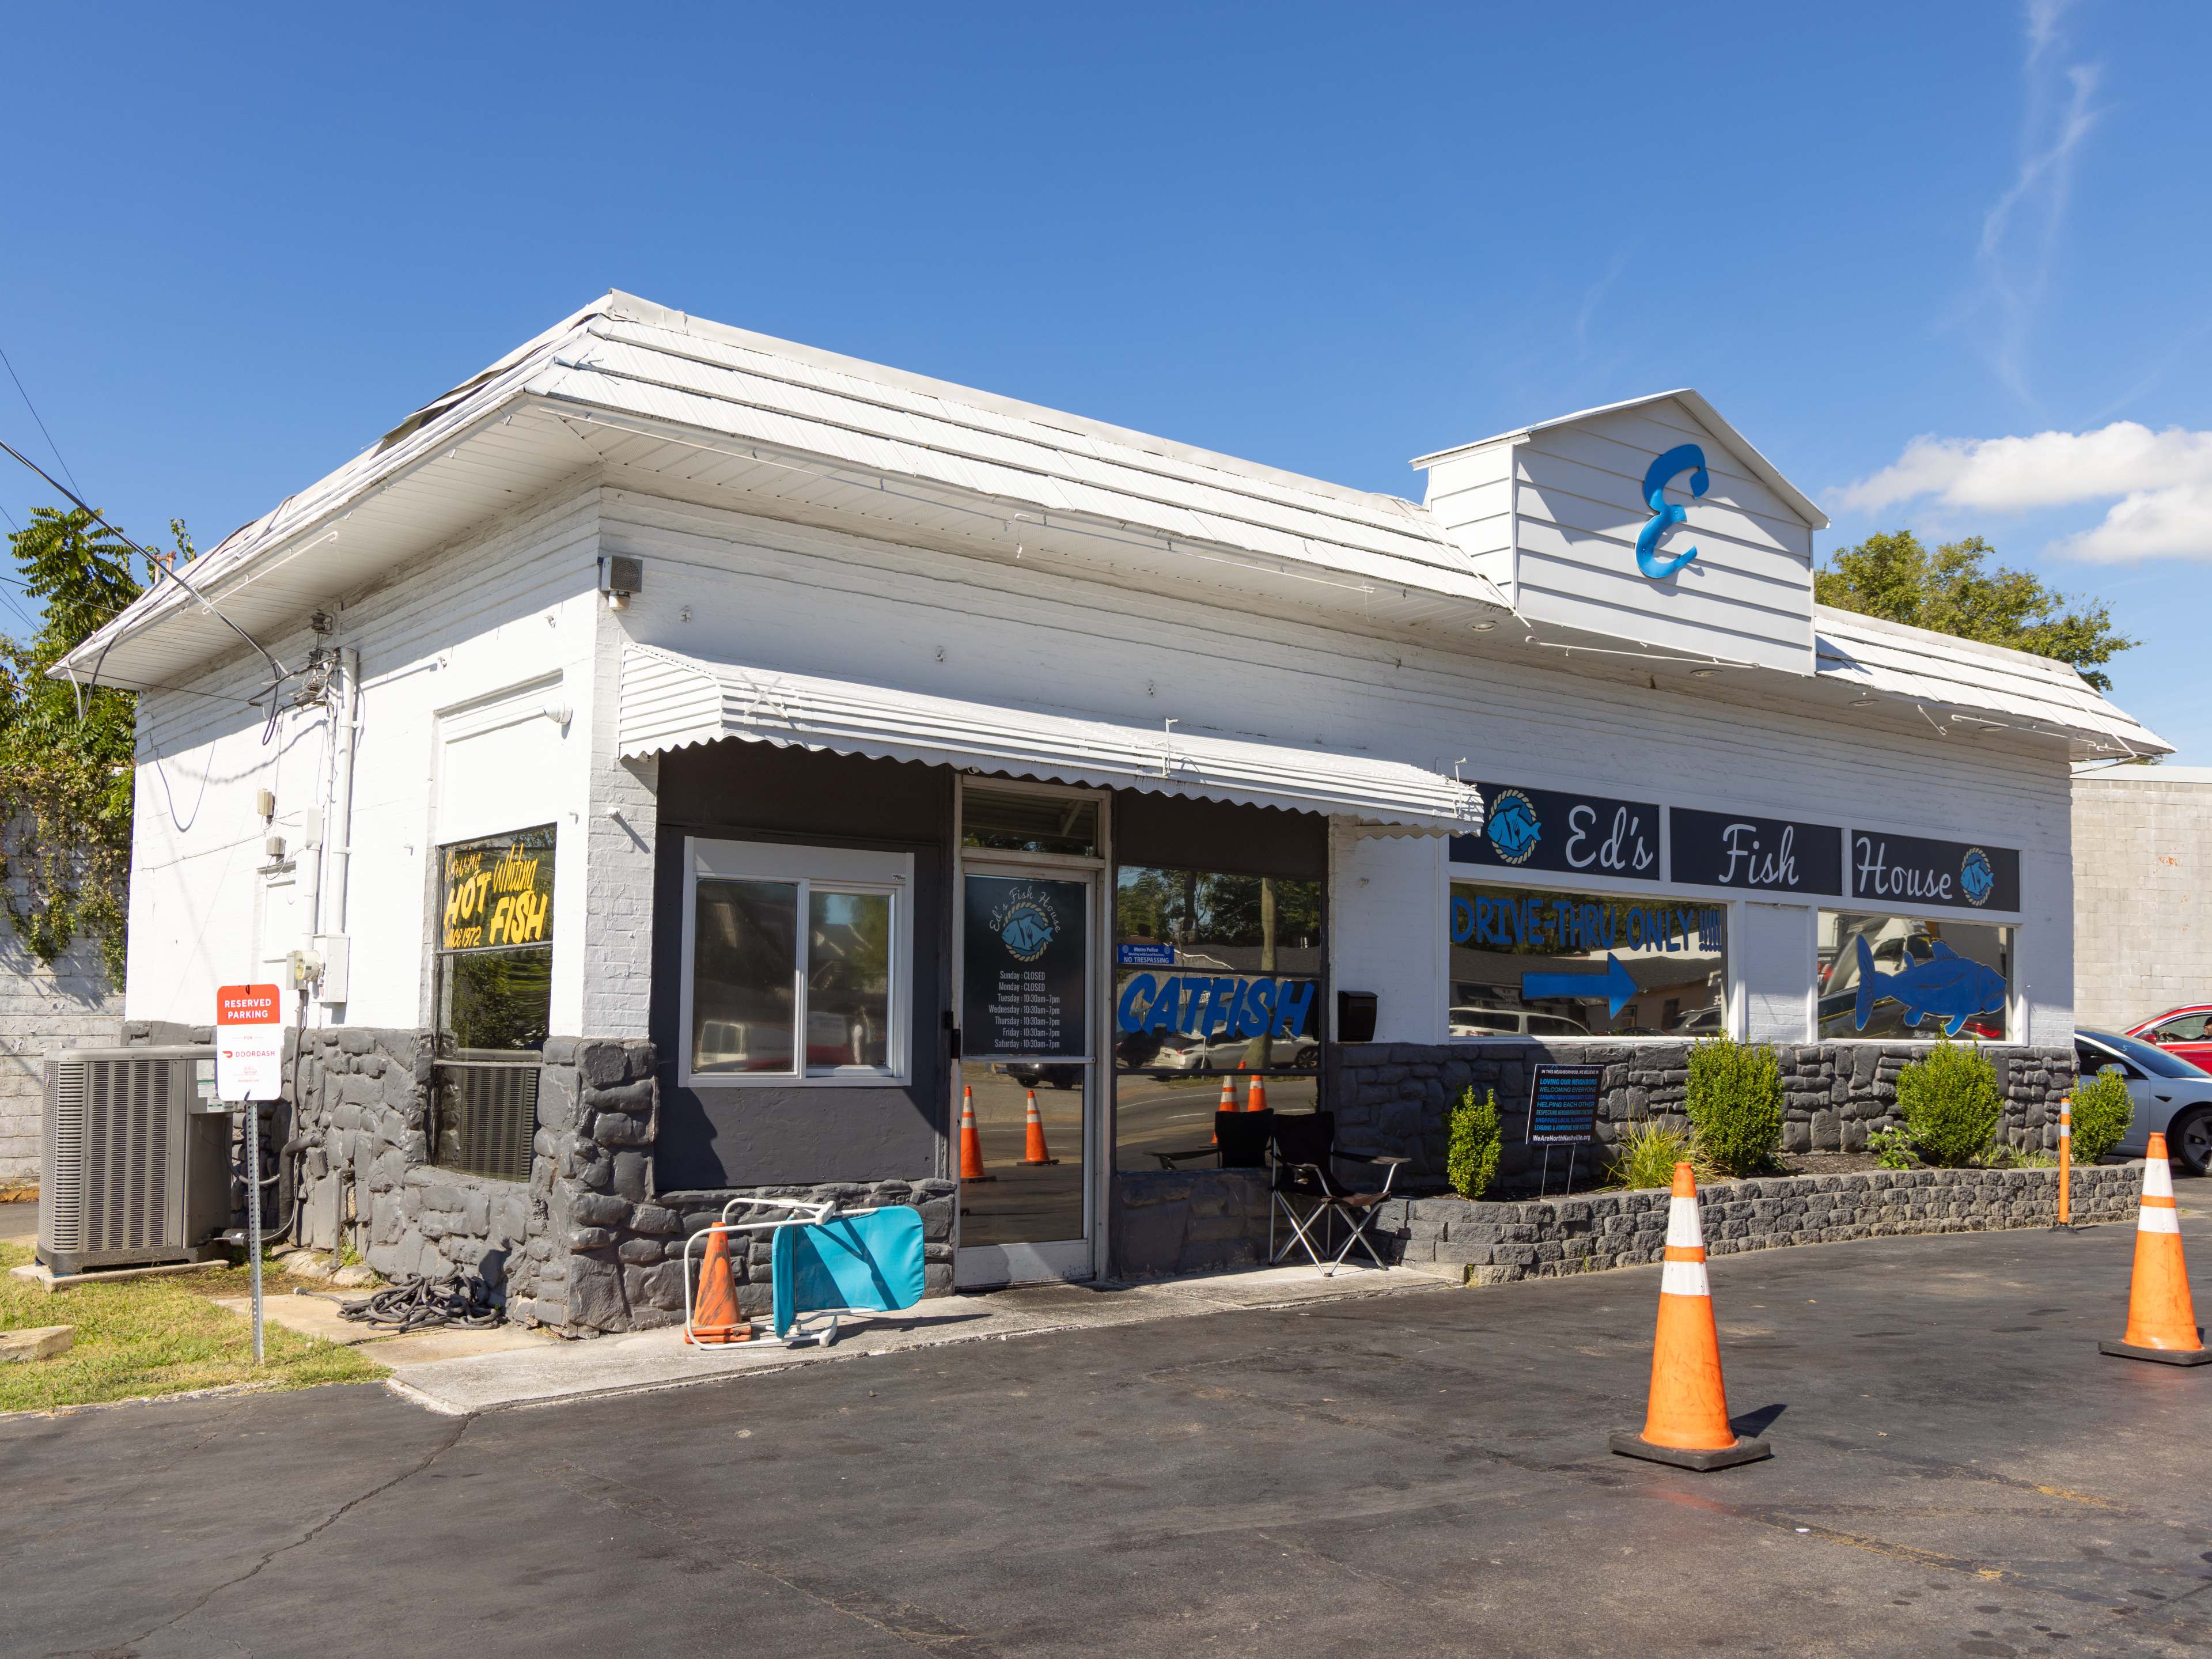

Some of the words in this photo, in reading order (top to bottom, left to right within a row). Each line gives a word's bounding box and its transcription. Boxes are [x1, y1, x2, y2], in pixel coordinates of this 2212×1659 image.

[1635, 444, 1709, 579] E
[1565, 805, 1654, 870] Ed's
[1718, 824, 1799, 883] Fish
[1856, 837, 1953, 900] House
[493, 842, 538, 893] Whiting
[444, 872, 492, 931] HOT
[489, 891, 548, 945] FISH
[989, 903, 1008, 931] Ed's
[1009, 885, 1033, 904] Fish
[1039, 892, 1060, 933] House
[1450, 896, 1615, 950] DRIVE-THRU
[461, 925, 482, 948] 1972
[1000, 971, 1020, 980] Sunday
[1024, 971, 1046, 980] CLOSED
[999, 982, 1020, 992] Monday
[1024, 983, 1046, 991] CLOSED
[224, 998, 271, 1008] RESERVED
[997, 993, 1020, 1003] Tuesday
[988, 1005, 1020, 1014] Wednesday
[1118, 974, 1315, 1037] CATFISH
[228, 1010, 268, 1019] PARKING
[995, 1016, 1020, 1026] Thursday
[1003, 1028, 1020, 1037] Friday
[995, 1039, 1020, 1048] Saturday
